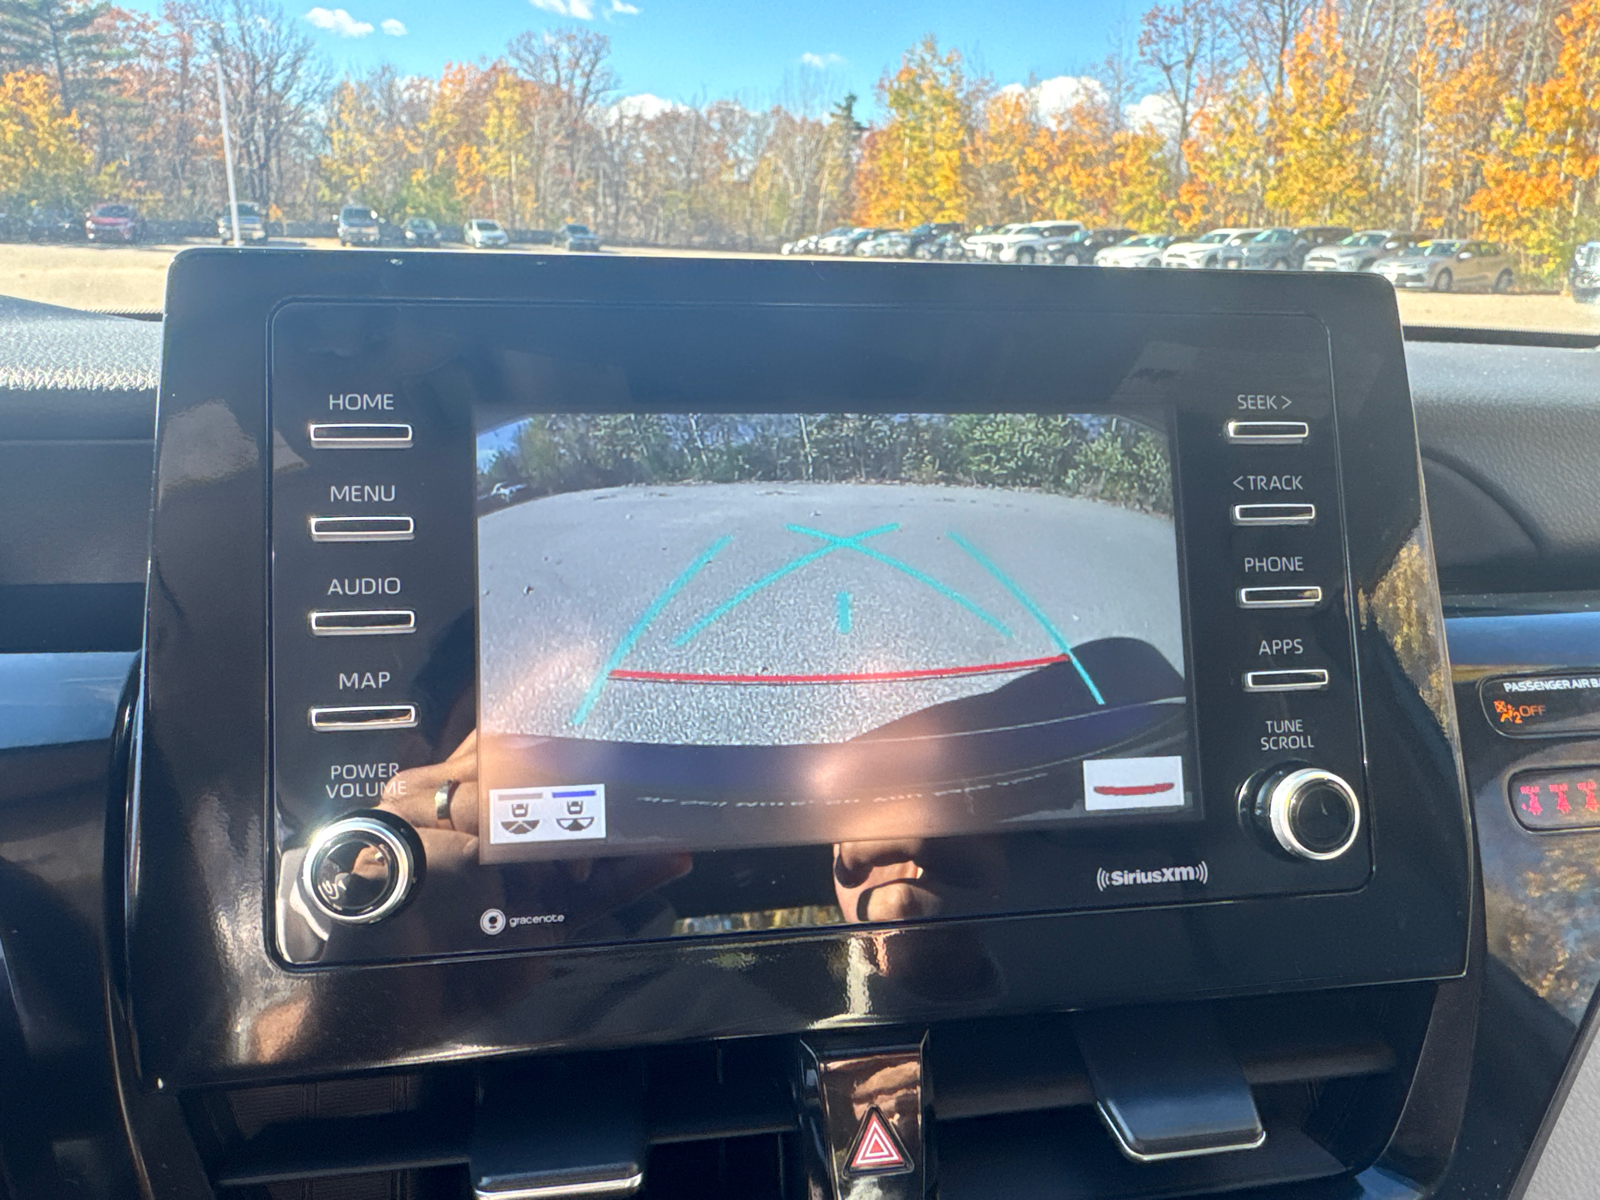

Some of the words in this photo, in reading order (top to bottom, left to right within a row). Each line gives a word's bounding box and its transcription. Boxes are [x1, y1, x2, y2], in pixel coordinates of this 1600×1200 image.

[329, 393, 395, 411] HOME
[1237, 394, 1278, 410] SEEK
[1246, 475, 1304, 491] TRACK
[330, 485, 396, 502] MENU
[1244, 556, 1305, 573] PHONE
[327, 577, 401, 596] AUDIO
[1258, 638, 1304, 656] APPS
[339, 671, 391, 690] MAP
[1503, 680, 1572, 692] PASSENGER
[1571, 678, 1592, 689] AIR
[1518, 704, 1546, 717] OFF
[1265, 719, 1304, 733] TUNE
[1260, 735, 1315, 751] SCROLL
[330, 763, 401, 780] POWER
[325, 780, 408, 799] VOLUME
[509, 914, 565, 928] gracenote
